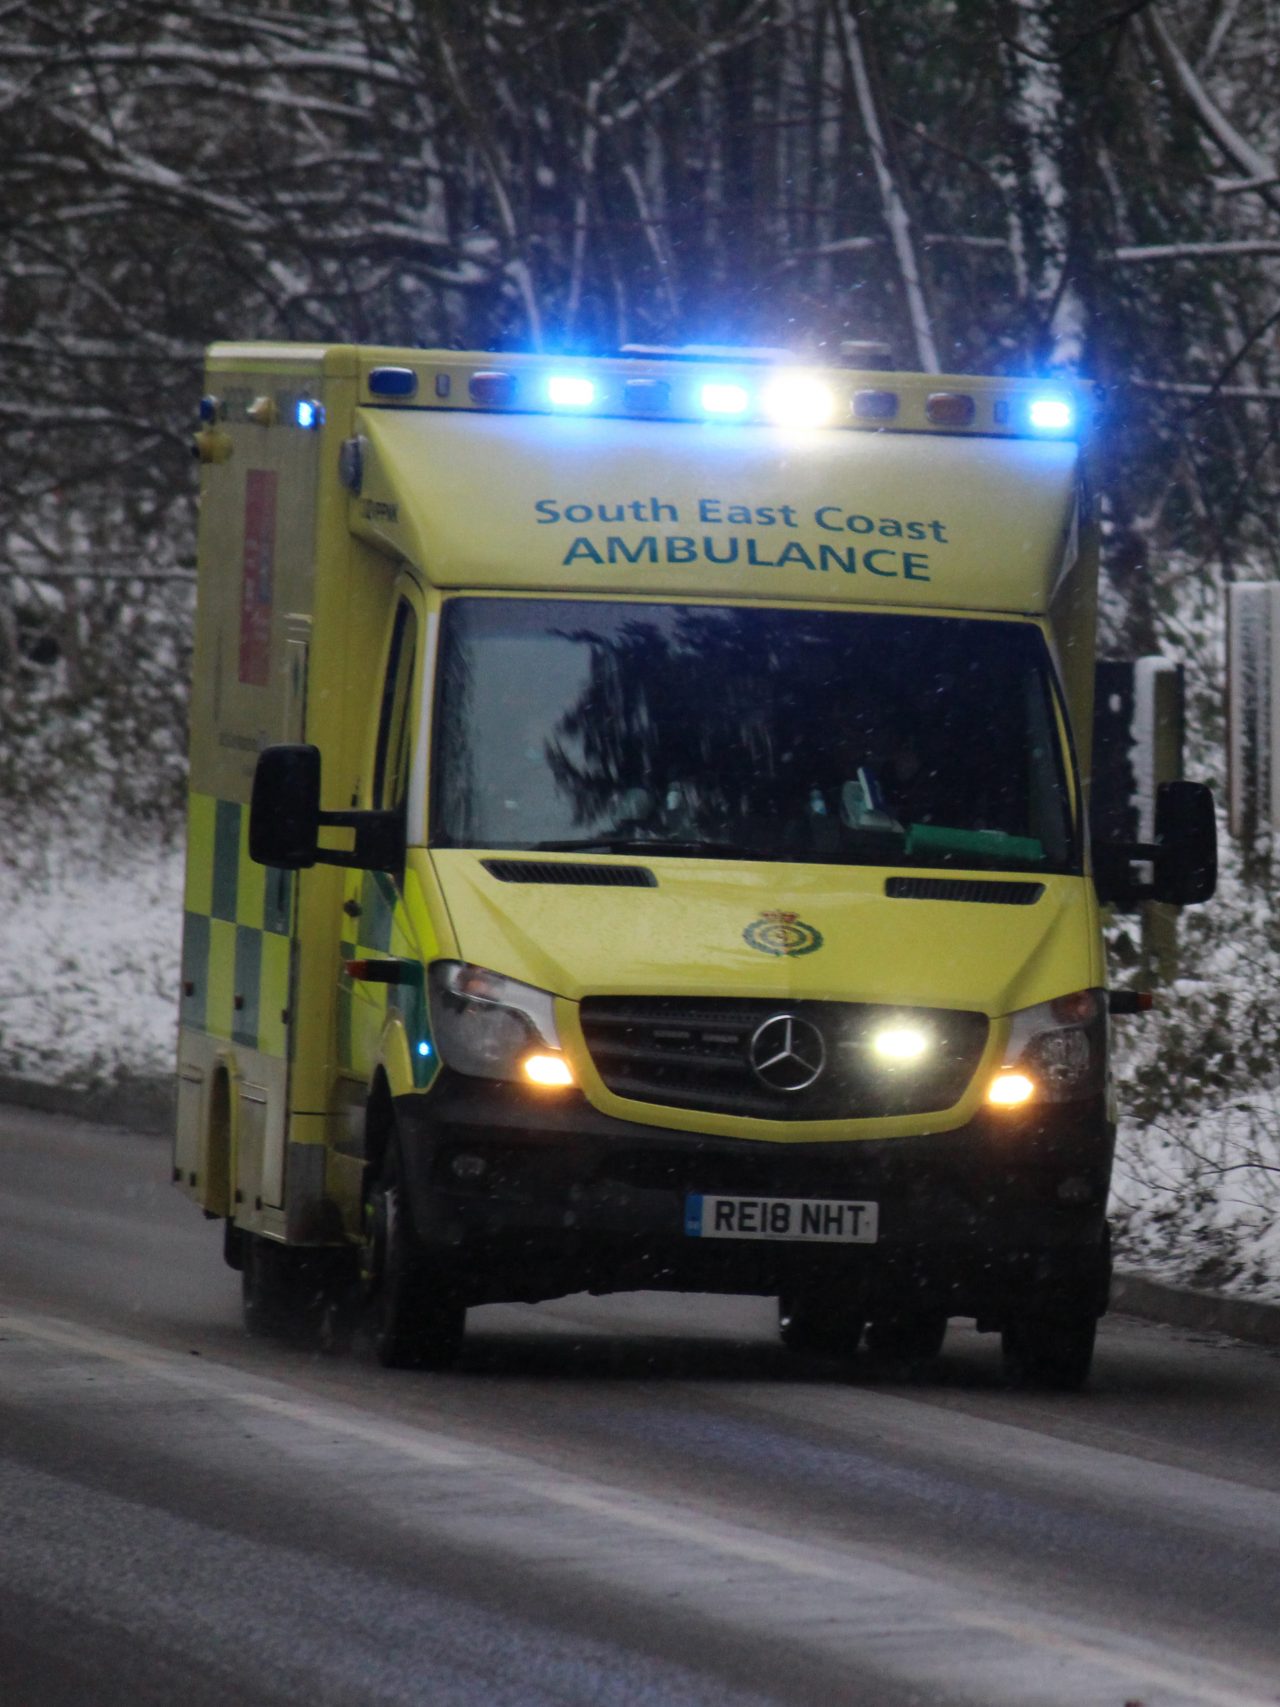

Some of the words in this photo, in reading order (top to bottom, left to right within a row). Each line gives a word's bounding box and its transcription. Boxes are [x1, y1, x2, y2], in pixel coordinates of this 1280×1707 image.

[534, 497, 678, 525] South
[699, 498, 799, 528] East
[814, 506, 949, 543] Coast
[562, 536, 931, 582] AMBULANCE
[714, 1200, 791, 1234] RE18
[801, 1203, 866, 1237] NHT
